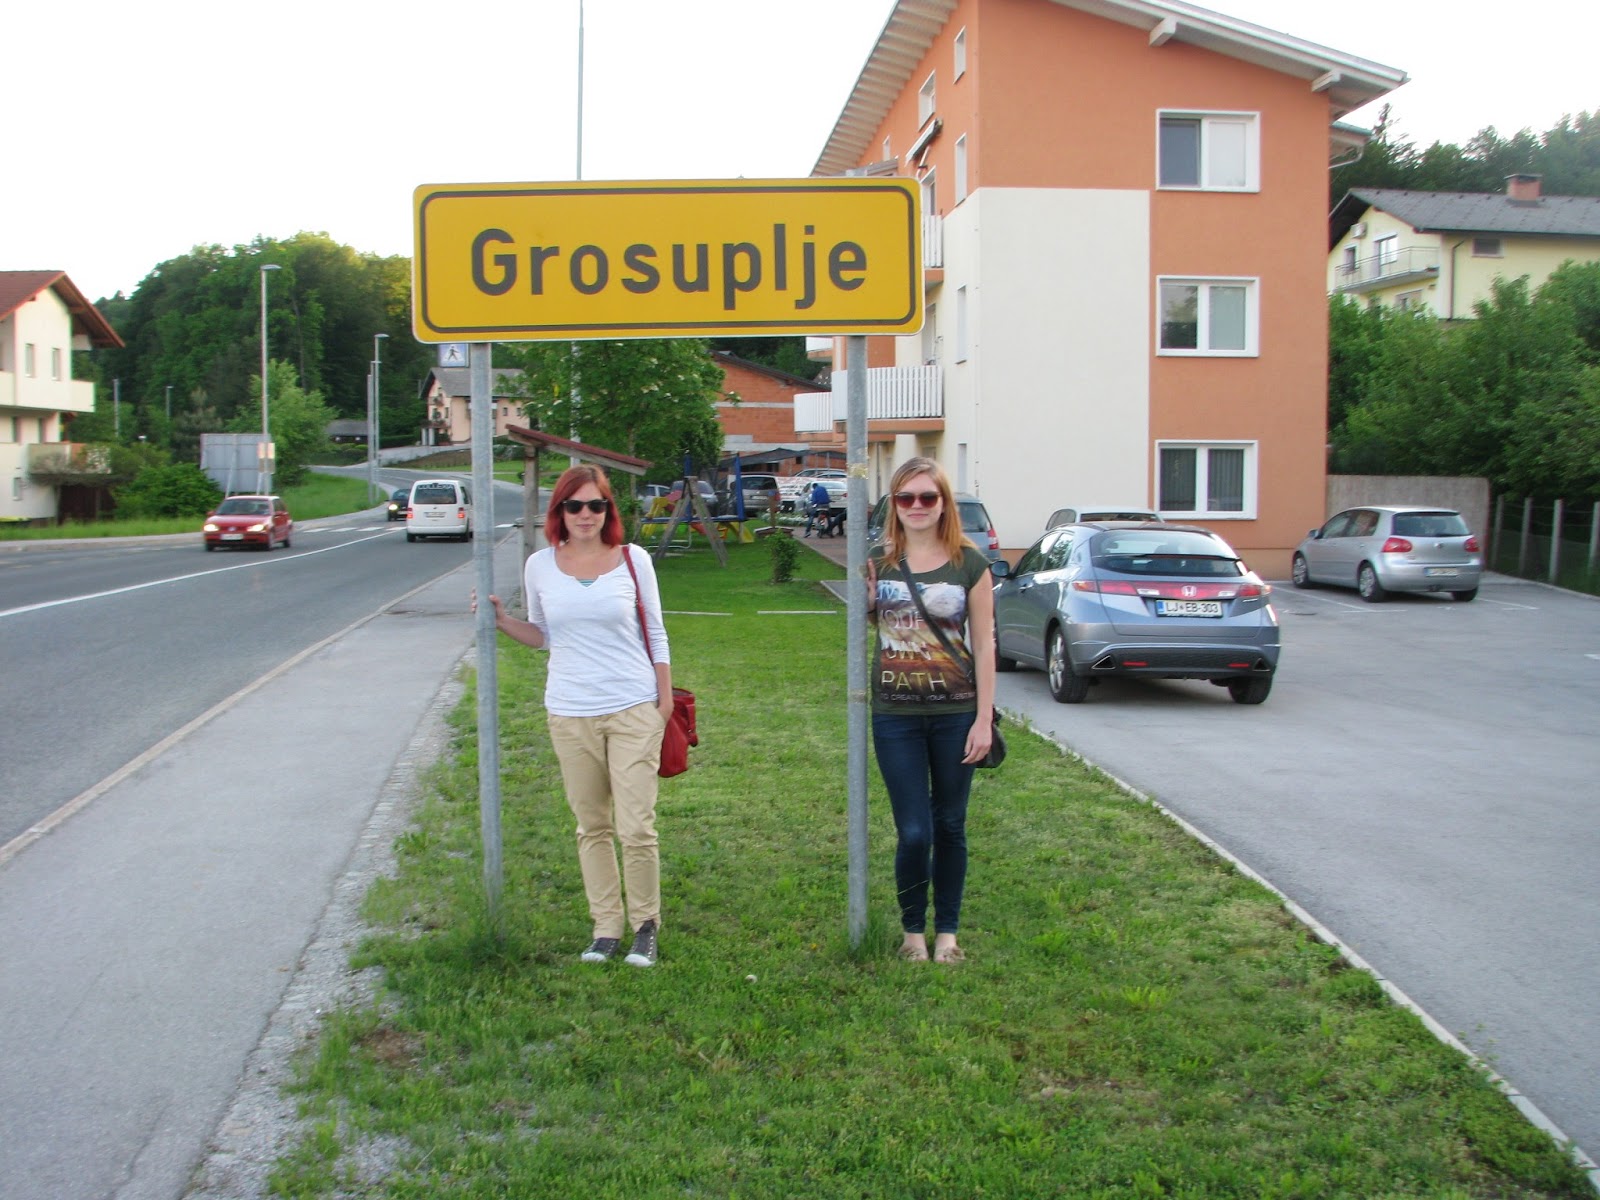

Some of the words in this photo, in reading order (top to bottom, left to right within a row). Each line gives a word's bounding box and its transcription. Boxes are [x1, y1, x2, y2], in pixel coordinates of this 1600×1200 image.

[471, 223, 868, 311] Grosuplje
[1166, 602, 1178, 612] LJ
[1185, 602, 1219, 613] EB-303
[881, 670, 948, 691] PATH
